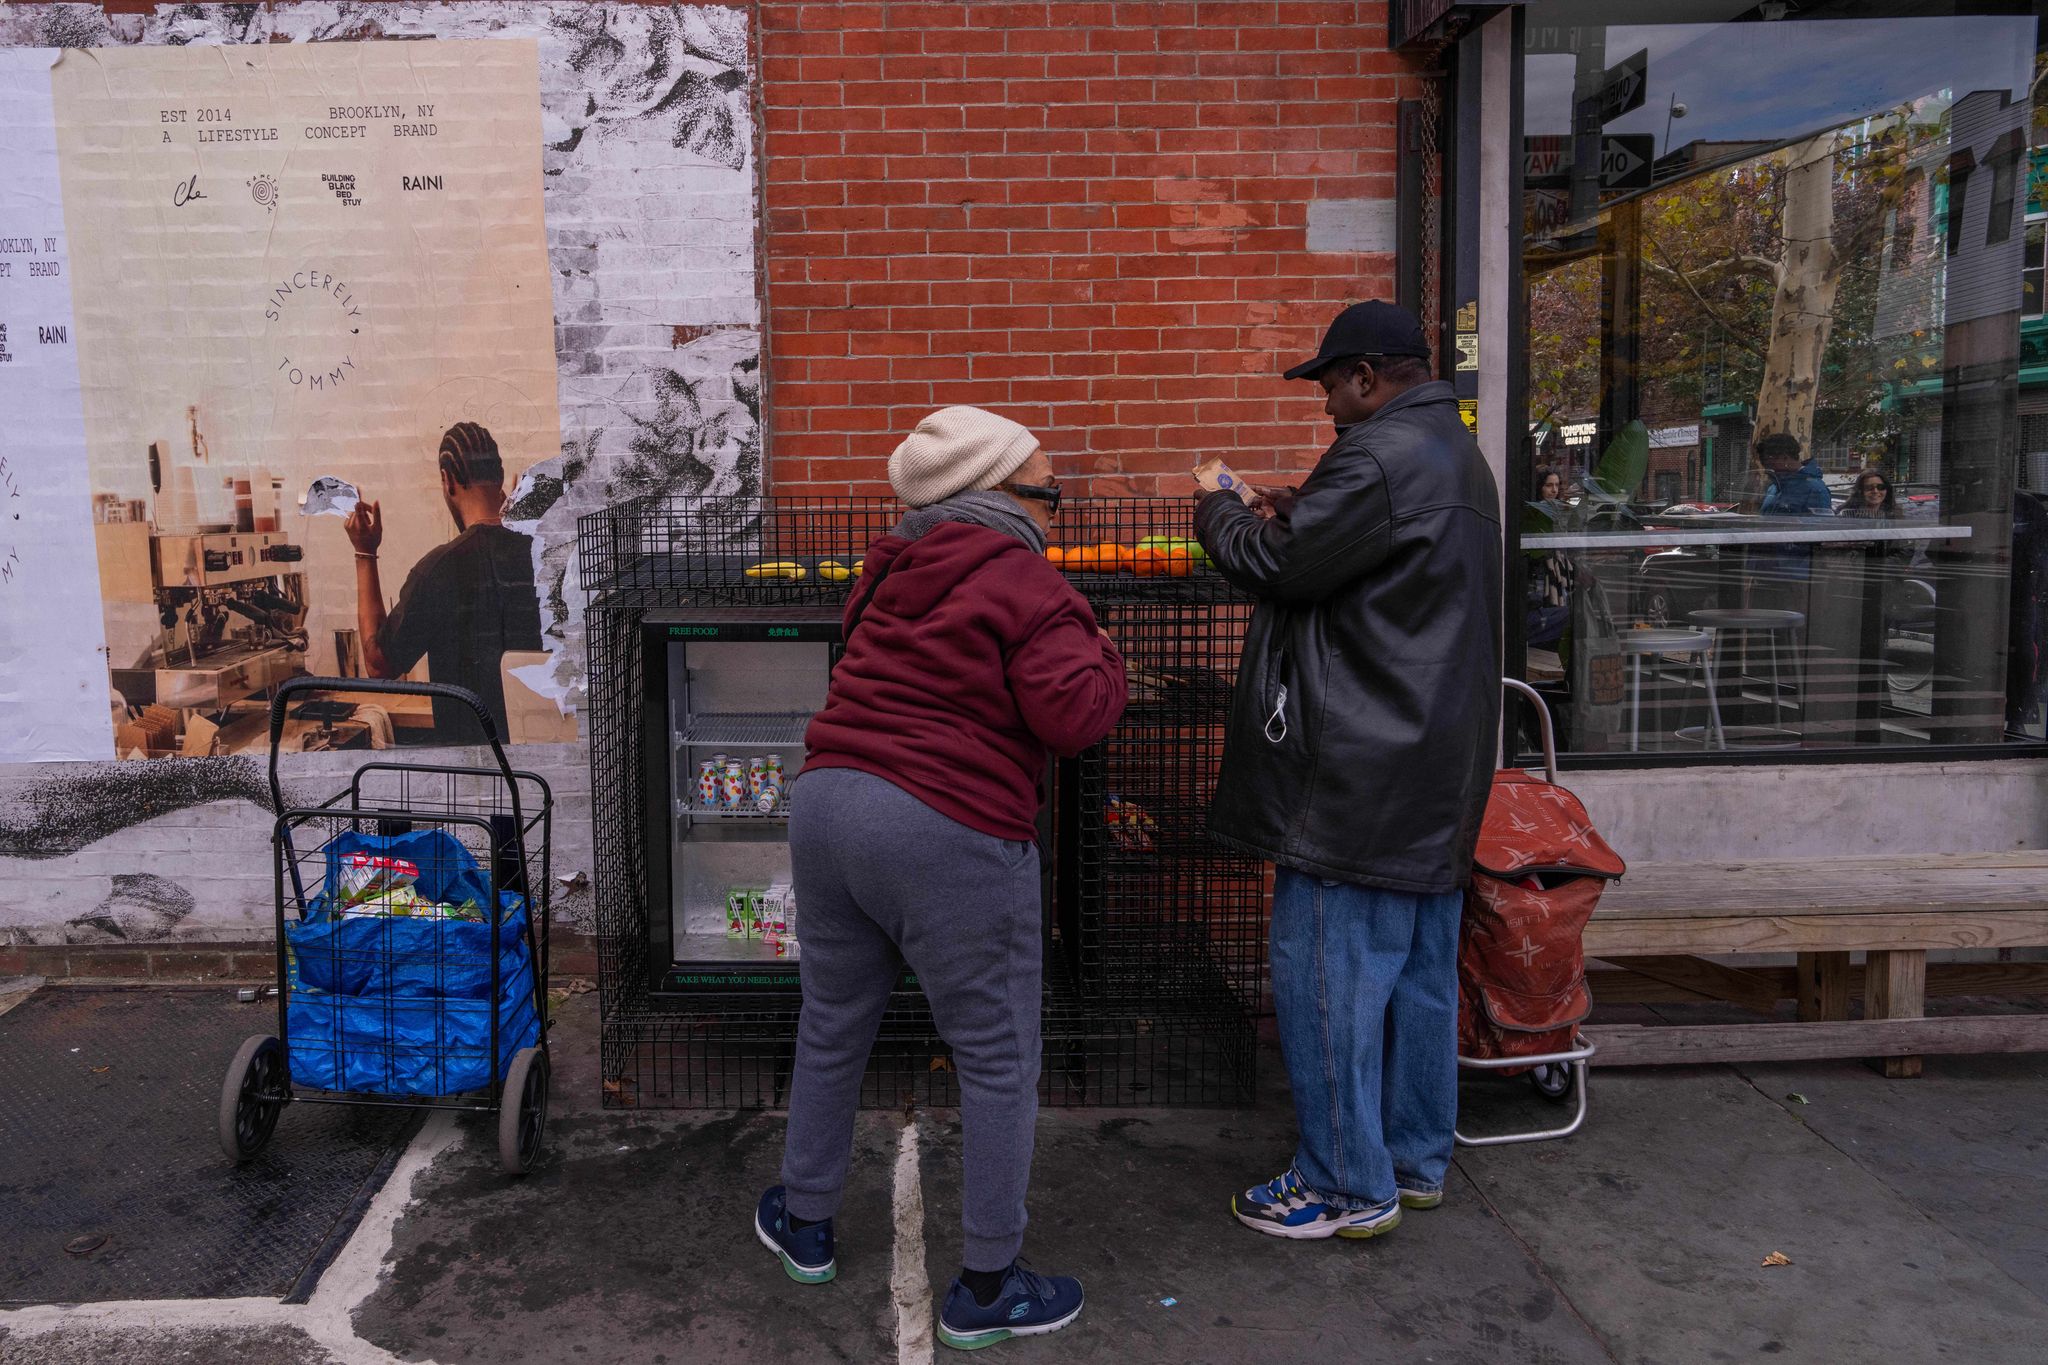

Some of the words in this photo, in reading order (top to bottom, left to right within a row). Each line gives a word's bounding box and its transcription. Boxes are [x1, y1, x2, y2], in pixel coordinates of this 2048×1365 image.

[160, 110, 187, 122] EST
[197, 108, 231, 122] 2014
[329, 105, 406, 119] BROOKLYN,
[417, 105, 435, 117] NY
[162, 130, 172, 143] A
[198, 128, 279, 142] LIFESTYLE
[305, 125, 367, 139] CONCEPT
[393, 124, 438, 137] BRAND
[321, 173, 356, 182] BUILDING
[402, 175, 443, 191] RAINI
[328, 182, 356, 190] BLACK
[335, 190, 352, 198] BED
[342, 198, 362, 206] STUY
[0, 238, 38, 255] OKLYN,
[43, 237, 57, 252] NY
[29, 261, 60, 277] BRAND
[38, 325, 68, 344] RAINI
[279, 355, 356, 391] TOMMY
[1559, 422, 1597, 438] TOMPKINS
[1564, 436, 1578, 446] GRAB
[1583, 435, 1591, 444] GO
[669, 627, 691, 635] FREE
[692, 627, 719, 635] FOOD!
[676, 975, 699, 984] TAKE
[700, 975, 727, 984] WHAT
[728, 975, 746, 984] YOU
[747, 975, 773, 985] NEED,
